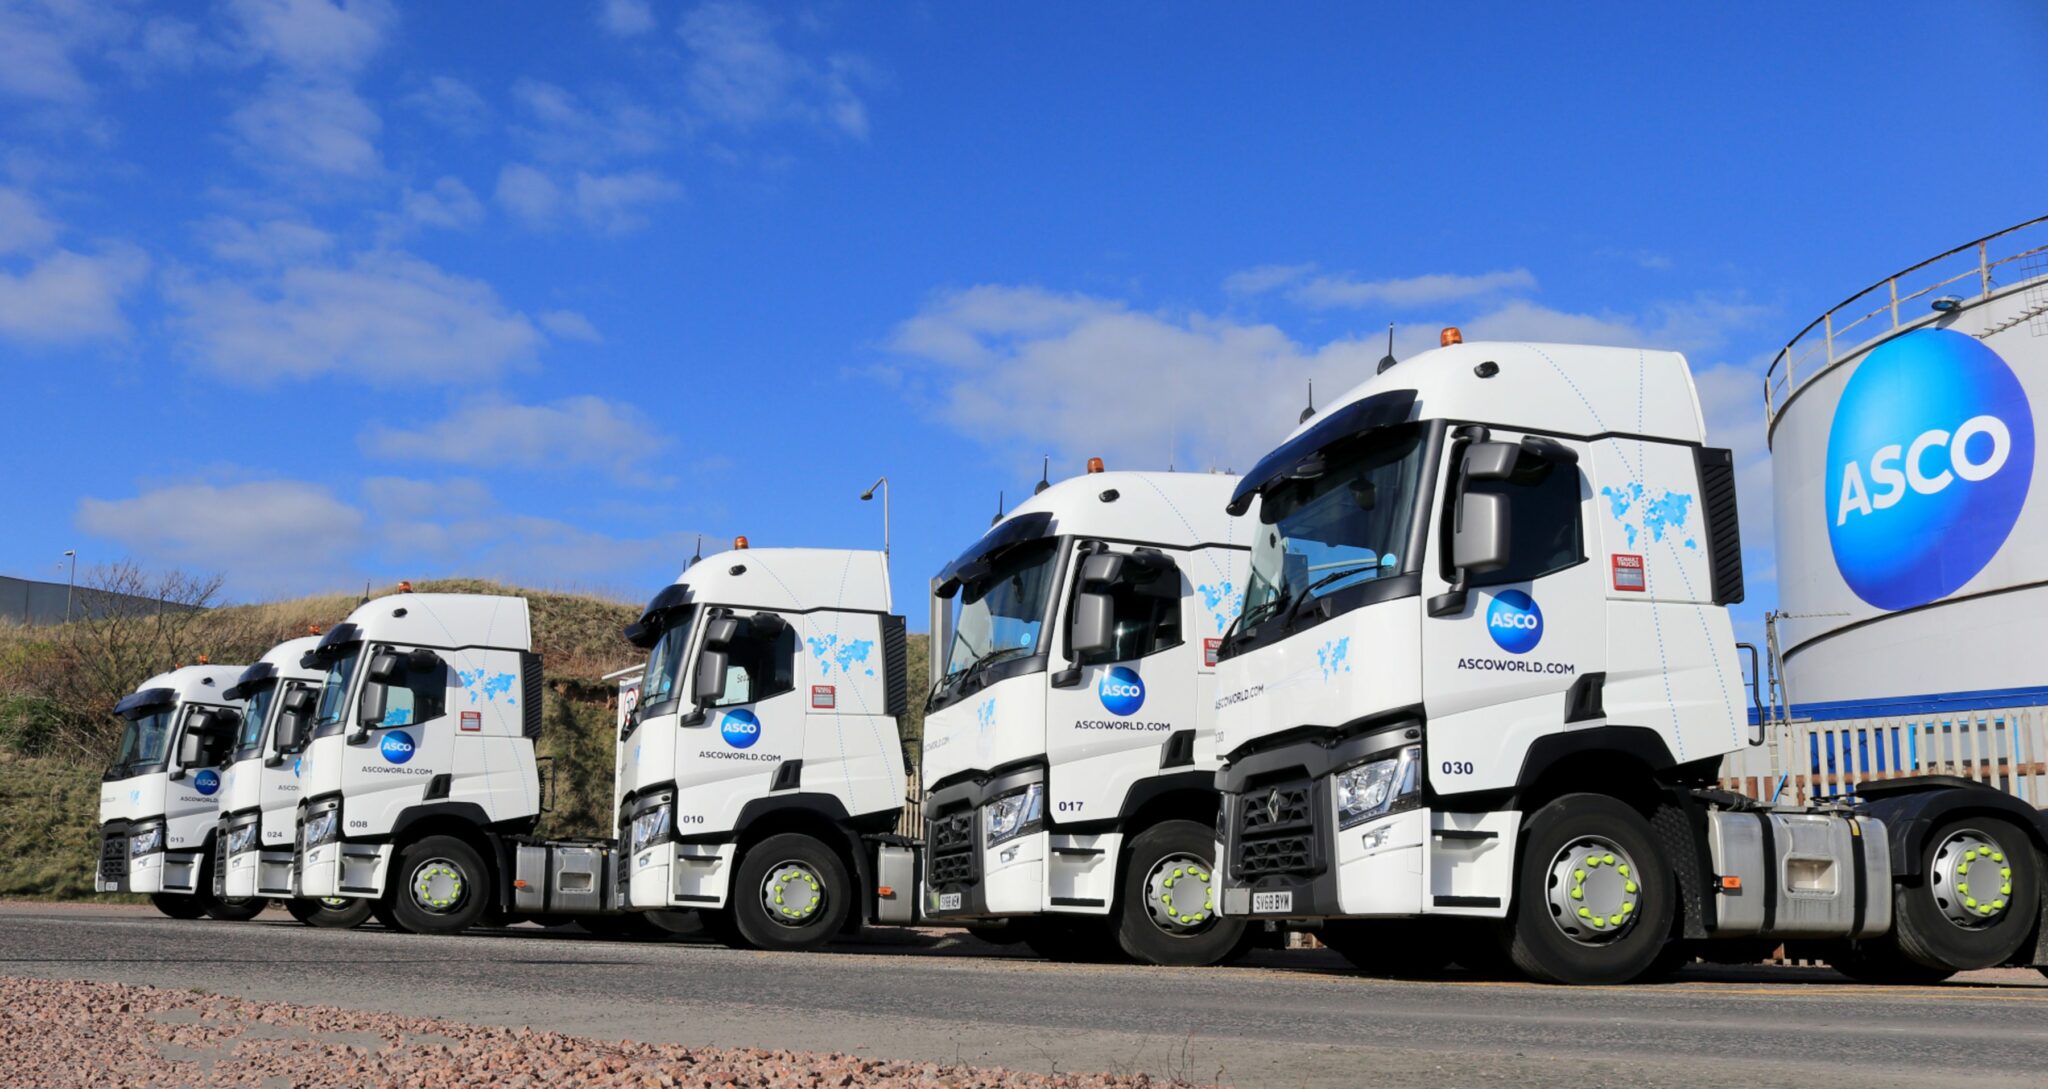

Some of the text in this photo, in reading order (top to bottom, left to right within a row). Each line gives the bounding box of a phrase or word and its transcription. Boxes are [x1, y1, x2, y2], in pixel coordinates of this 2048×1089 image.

[1837, 415, 2011, 527] ASCO
[1490, 612, 1538, 630] ASCO
[1457, 658, 1575, 675] ASCOWORLD.COM
[1102, 684, 1141, 697] ASCO
[723, 723, 757, 734] ASCO
[1074, 720, 1171, 732] ASCOWORLD.COM
[382, 742, 412, 752] ASCO
[699, 751, 782, 762] ASCOWORLD.COM
[361, 766, 433, 775] ASCOWORLD.COM
[1441, 761, 1474, 775] 030
[196, 778, 218, 787] ASCO
[1058, 801, 1084, 812] 017
[349, 820, 368, 828] 008
[683, 815, 704, 824] 010
